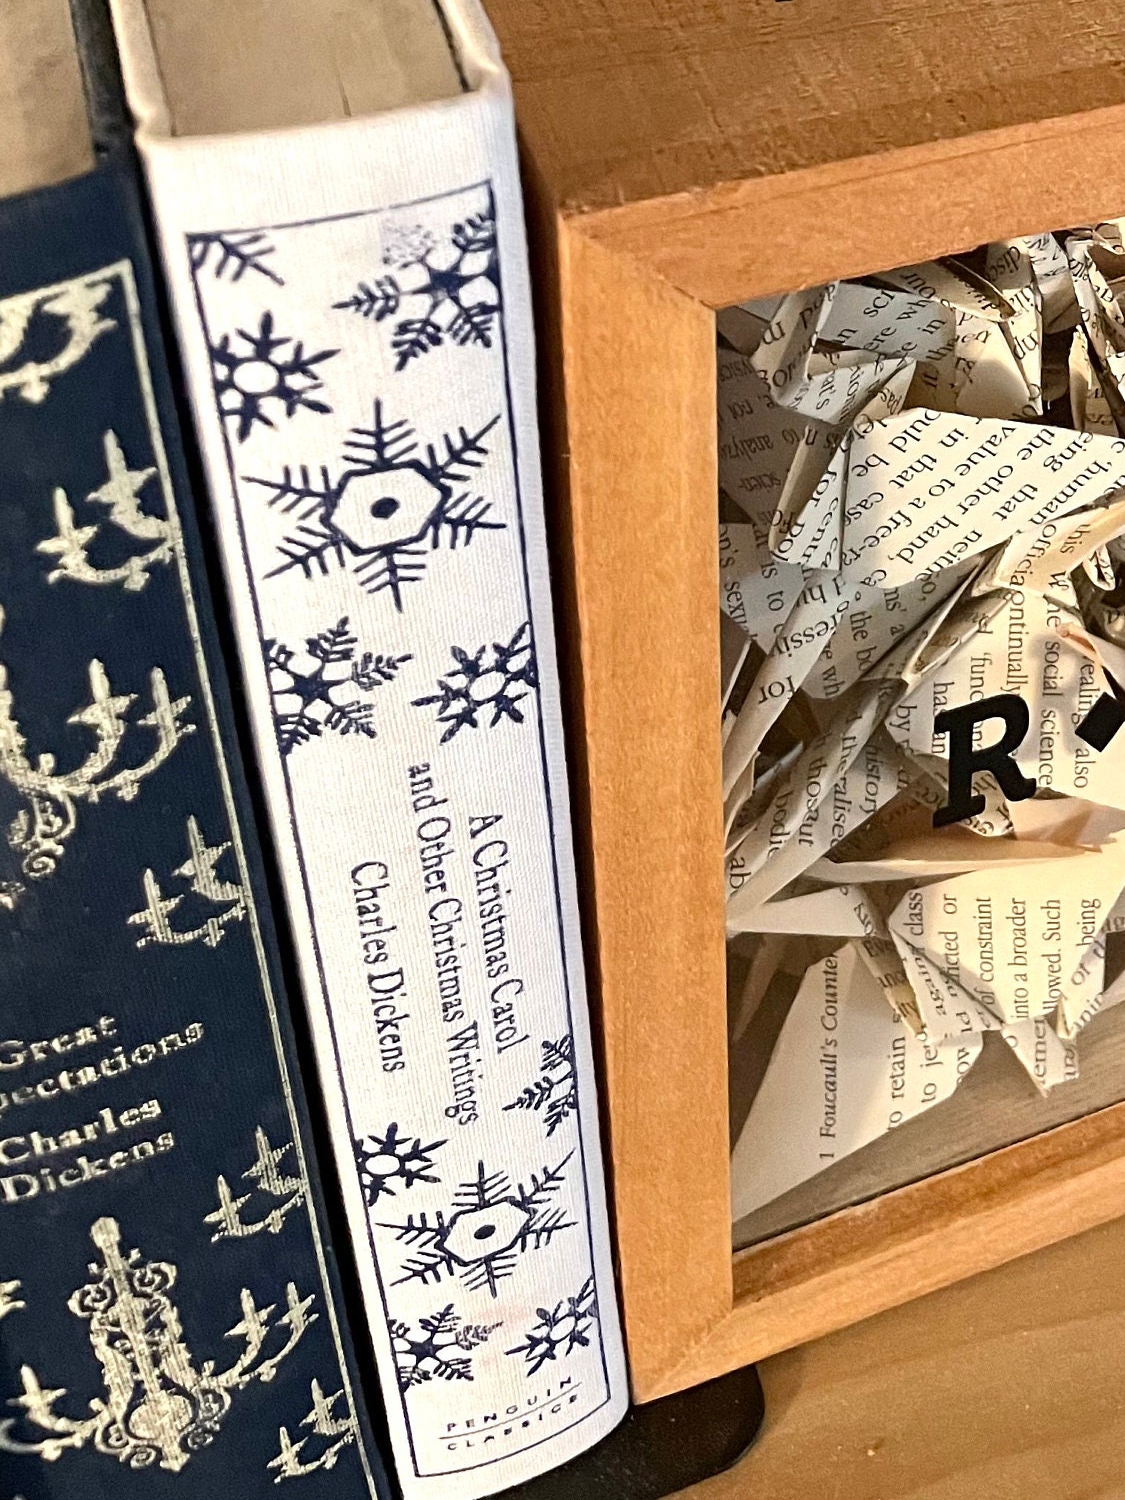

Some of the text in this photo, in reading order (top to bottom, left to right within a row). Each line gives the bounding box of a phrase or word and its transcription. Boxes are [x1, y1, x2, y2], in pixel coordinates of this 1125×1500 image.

[851, 452, 891, 478] be
[889, 426, 970, 490] in that
[953, 424, 1018, 478] value
[1016, 427, 1056, 462] the
[908, 496, 927, 511] a
[928, 476, 957, 499] to
[956, 464, 1015, 516] other
[991, 482, 1040, 522] that
[887, 519, 960, 567] hand,
[1037, 640, 1065, 788] social science
[1072, 746, 1098, 790] also
[903, 891, 924, 937] class
[943, 893, 959, 916] or
[1040, 898, 1062, 943] Such
[1075, 897, 1103, 947] being
[406, 760, 482, 1127] and Other Christmas Writings
[467, 812, 532, 1056] A Christmas Carol
[975, 895, 996, 985] constraint
[1006, 897, 1029, 969] broader
[349, 859, 411, 1075] Charles Dickens
[1013, 986, 1031, 1020] into
[0, 1014, 119, 1072] Great
[888, 1034, 908, 1101] retain
[819, 1043, 840, 1140] Foucault's
[0, 1097, 164, 1168] Charles
[0, 1130, 177, 1203] Dickens
[446, 1375, 572, 1433] PENGUIN
[446, 1392, 579, 1452] CLASSICS
